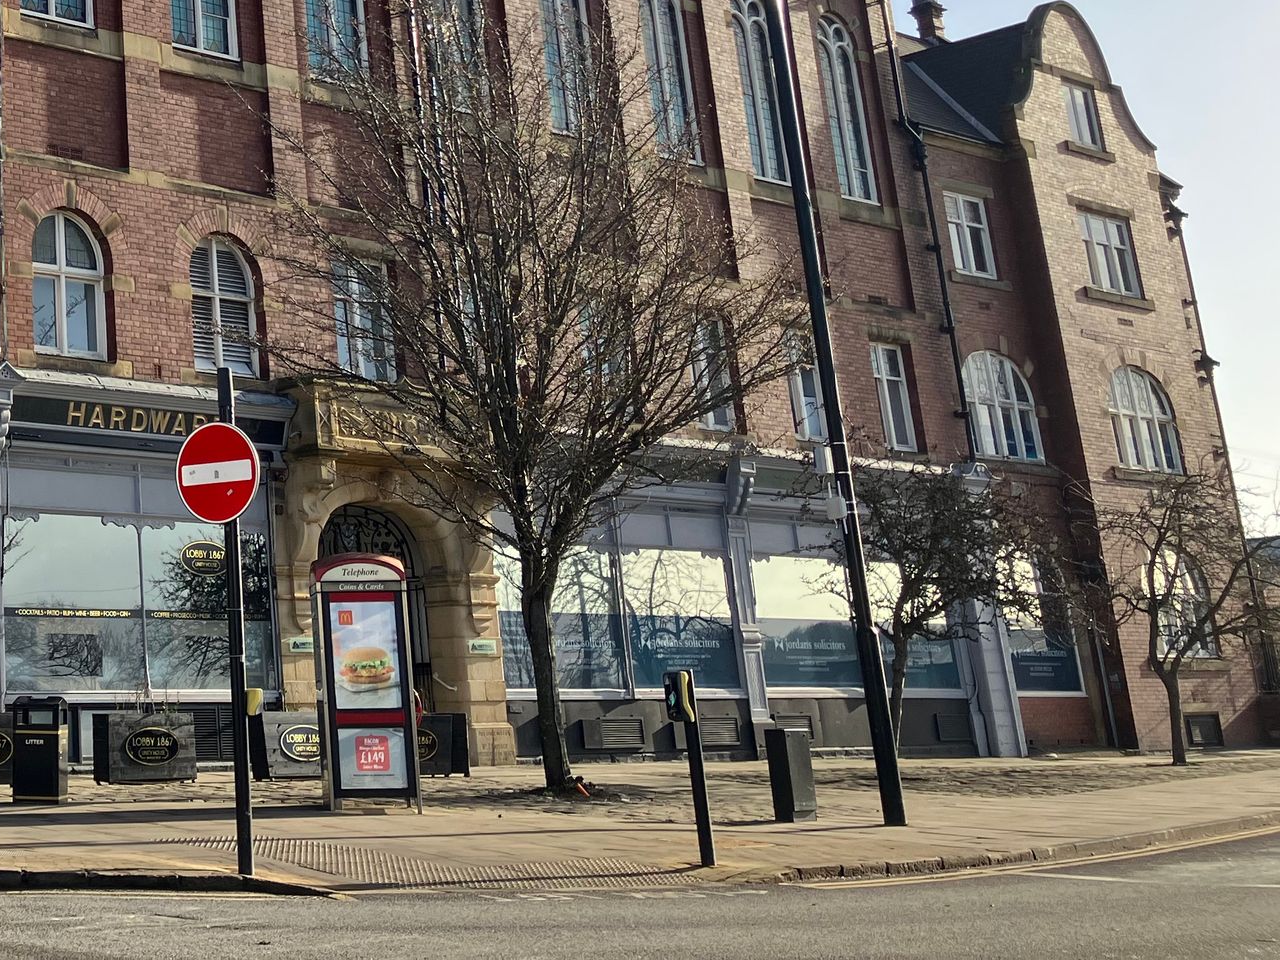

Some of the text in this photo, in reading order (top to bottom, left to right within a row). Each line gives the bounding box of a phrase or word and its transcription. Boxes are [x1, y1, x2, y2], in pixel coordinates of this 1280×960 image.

[66, 401, 220, 436] HARDWAR
[186, 549, 225, 560] LOBBY 1867
[341, 568, 379, 578] Telephone
[339, 583, 357, 591] Coins
[357, 583, 364, 591] &
[652, 635, 720, 650] jordans solicitors
[785, 638, 846, 652] jordans solicitors
[132, 736, 173, 746] LOBBY 1867
[286, 733, 320, 743] LOBBY 186
